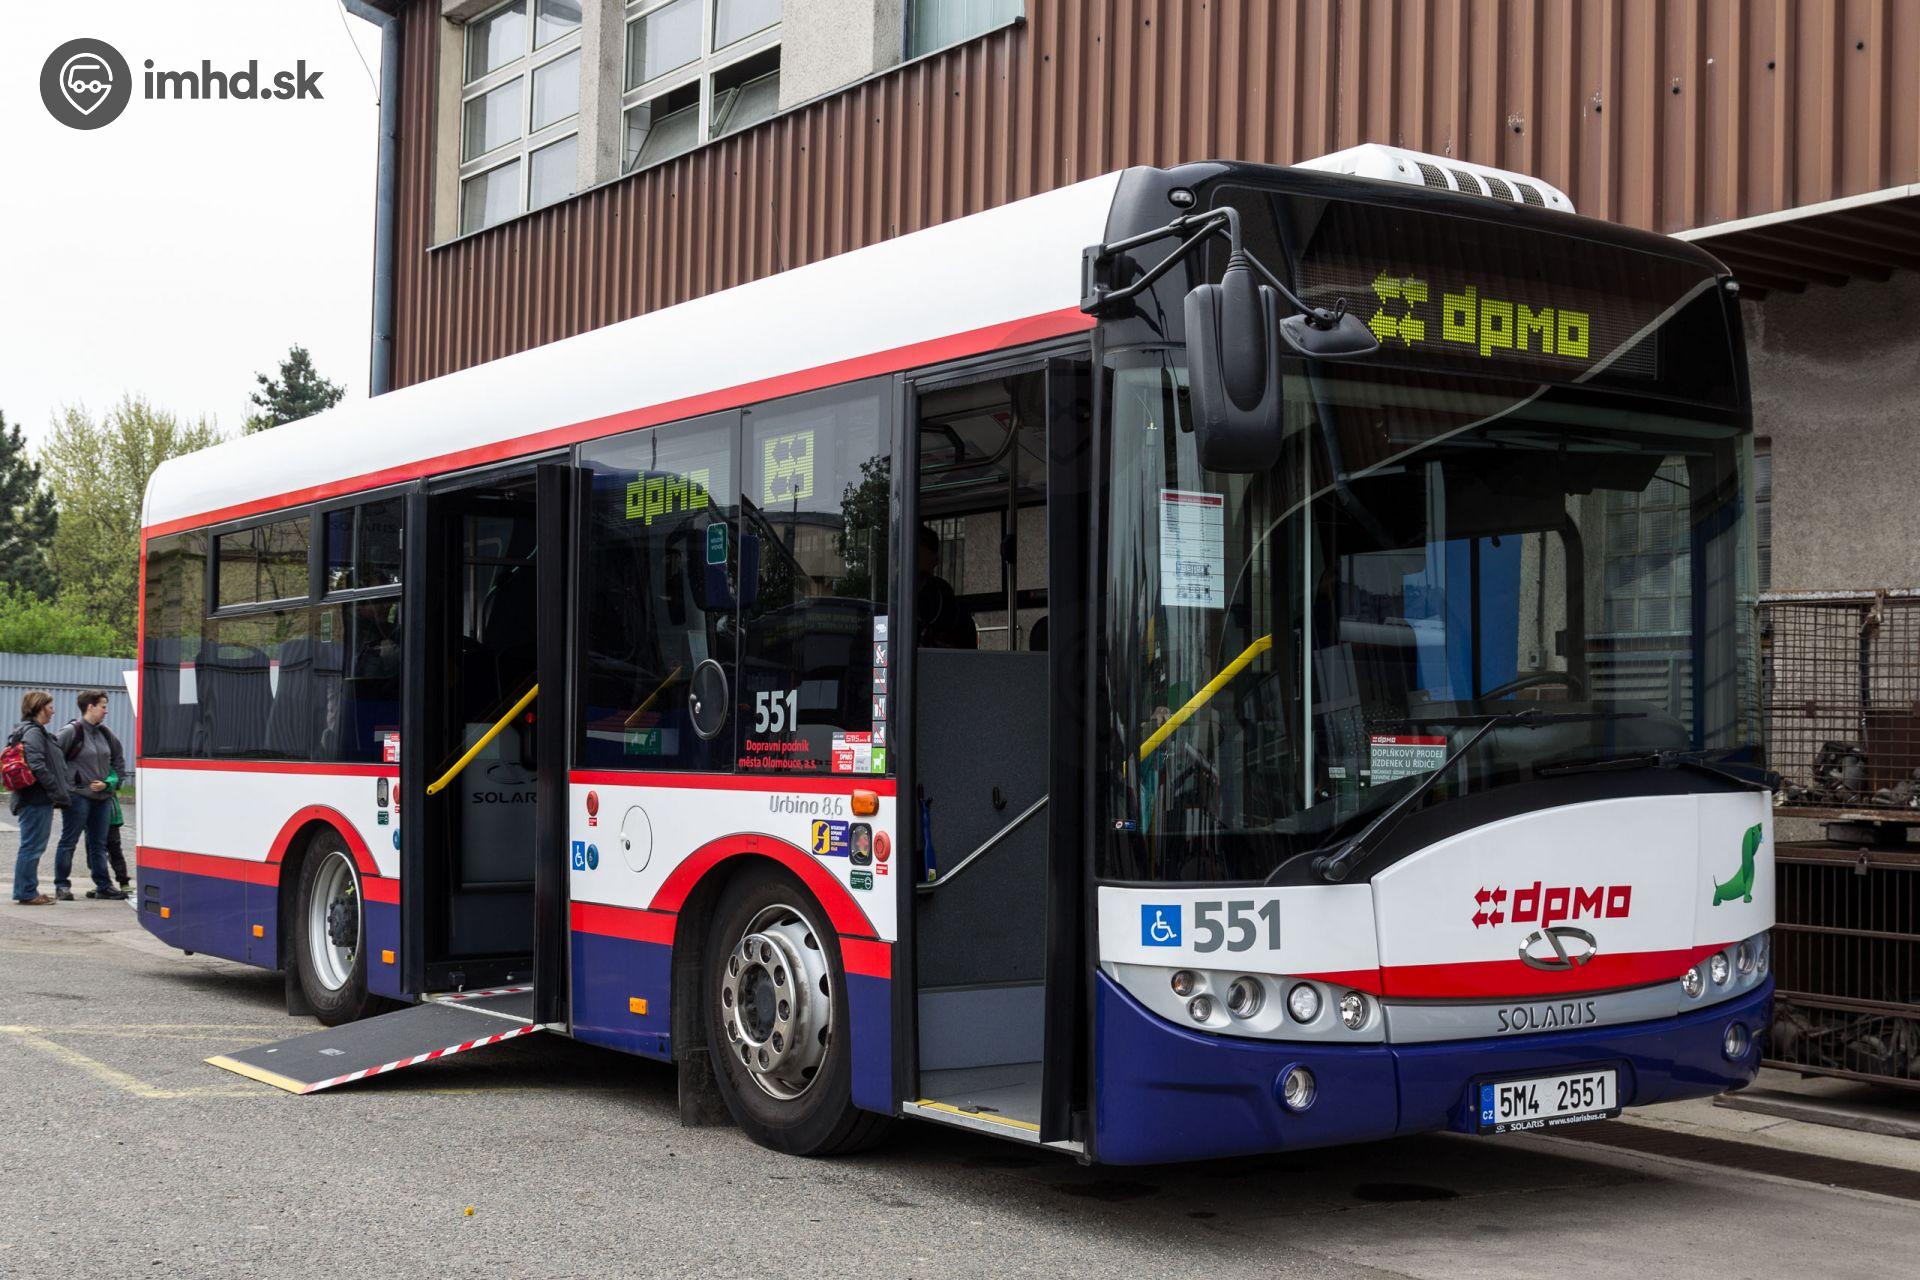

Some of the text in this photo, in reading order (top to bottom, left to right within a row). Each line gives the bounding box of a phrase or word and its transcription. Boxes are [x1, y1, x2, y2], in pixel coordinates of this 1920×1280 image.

[755, 689, 798, 733] 551
[746, 739, 810, 755] Dopravní podnik
[1372, 747, 1443, 758] DOPLŇKOVÝ PRODEJ
[738, 756, 762, 768] města
[1371, 757, 1435, 768] JÍZDENEK U ŘIDIČE
[769, 794, 843, 819] Urbino 8,6
[1193, 899, 1281, 954] 551
[1497, 1001, 1597, 1033] SOLARIS
[1500, 1076, 1605, 1118] 5M4 2551
[1482, 1110, 1494, 1120] CZ
[1549, 1113, 1607, 1126] www.solarisbus.cz
